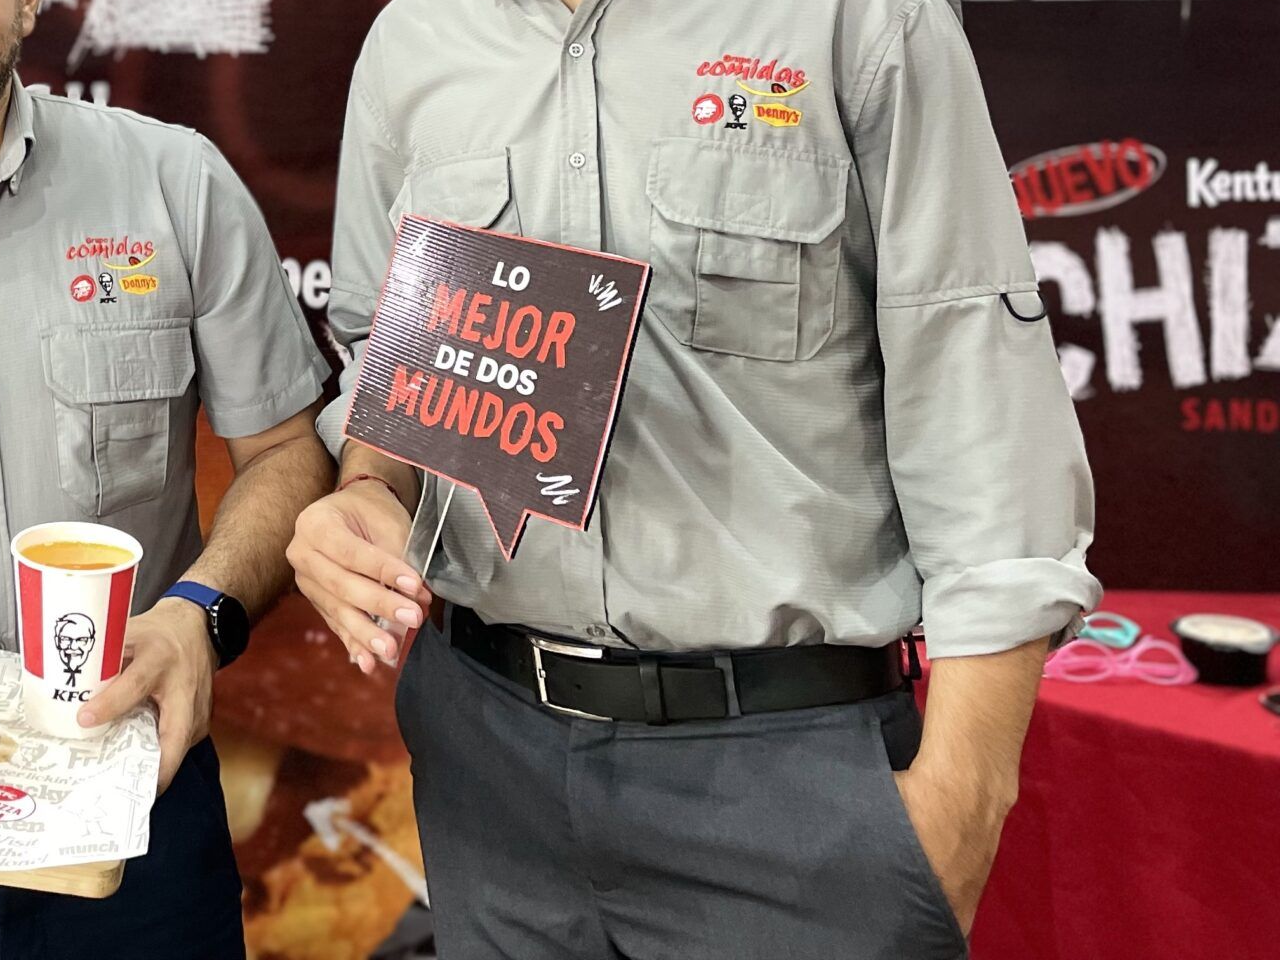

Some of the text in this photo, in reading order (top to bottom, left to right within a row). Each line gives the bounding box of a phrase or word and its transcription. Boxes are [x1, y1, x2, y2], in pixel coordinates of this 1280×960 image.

[696, 58, 806, 89] comidas
[756, 105, 800, 124] Denny's
[66, 235, 154, 260] comidas
[122, 278, 157, 290] Denny's
[491, 260, 531, 292] LO
[427, 283, 576, 369] MEJOR
[433, 344, 538, 396] DE DOS
[385, 364, 565, 463] MUNDOS
[52, 689, 92, 703] KFC
[57, 840, 120, 857] munch
